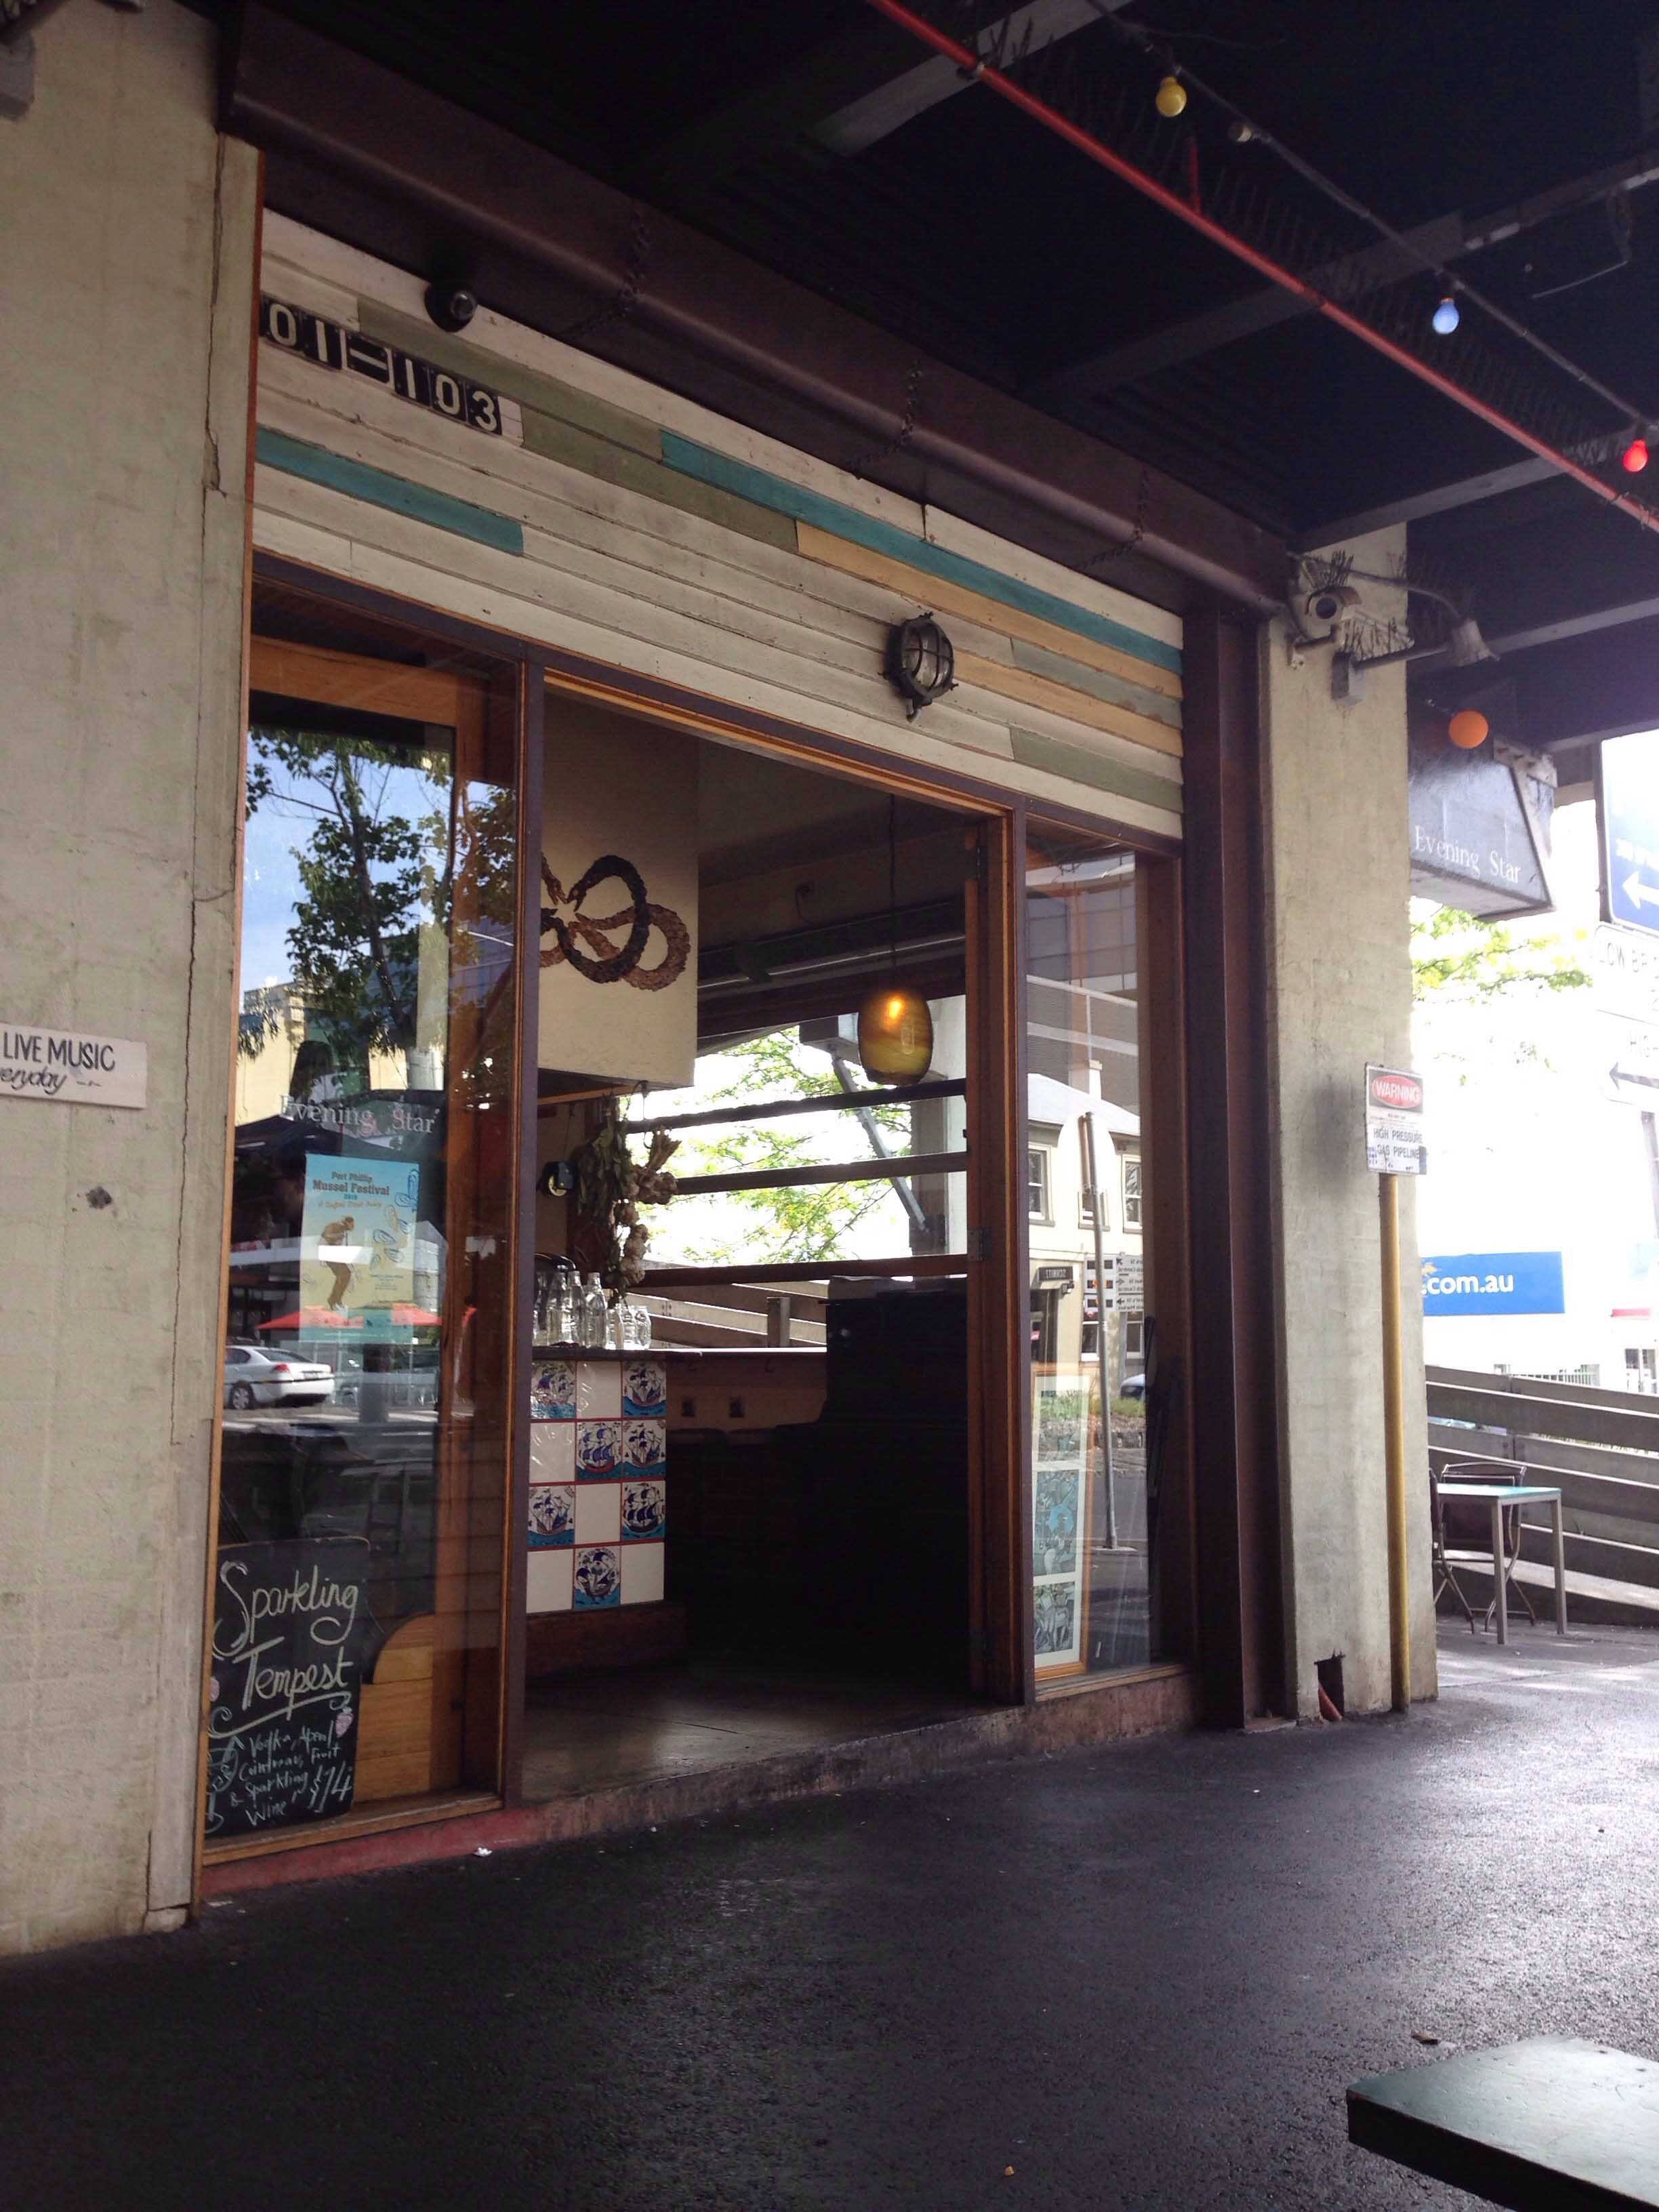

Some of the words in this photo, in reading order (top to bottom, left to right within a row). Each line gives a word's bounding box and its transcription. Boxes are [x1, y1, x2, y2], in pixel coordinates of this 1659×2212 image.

[1414, 825, 1480, 879] Evening
[1490, 851, 1521, 884] Star
[3, 1031, 42, 1063] LIVE
[48, 1036, 115, 1072] MUSIC
[1376, 1080, 1420, 1103] WARNING
[279, 1094, 373, 1137] Evening
[392, 1106, 434, 1134] Star
[1377, 1144, 1390, 1156] GAS
[1393, 1146, 1420, 1160] PIPELINE
[312, 1179, 348, 1192] Mussel
[351, 1183, 390, 1195] Festival
[211, 1561, 359, 1660] Sparkling
[232, 1635, 354, 1721] Tempest
[245, 1800, 287, 1826] Wine
